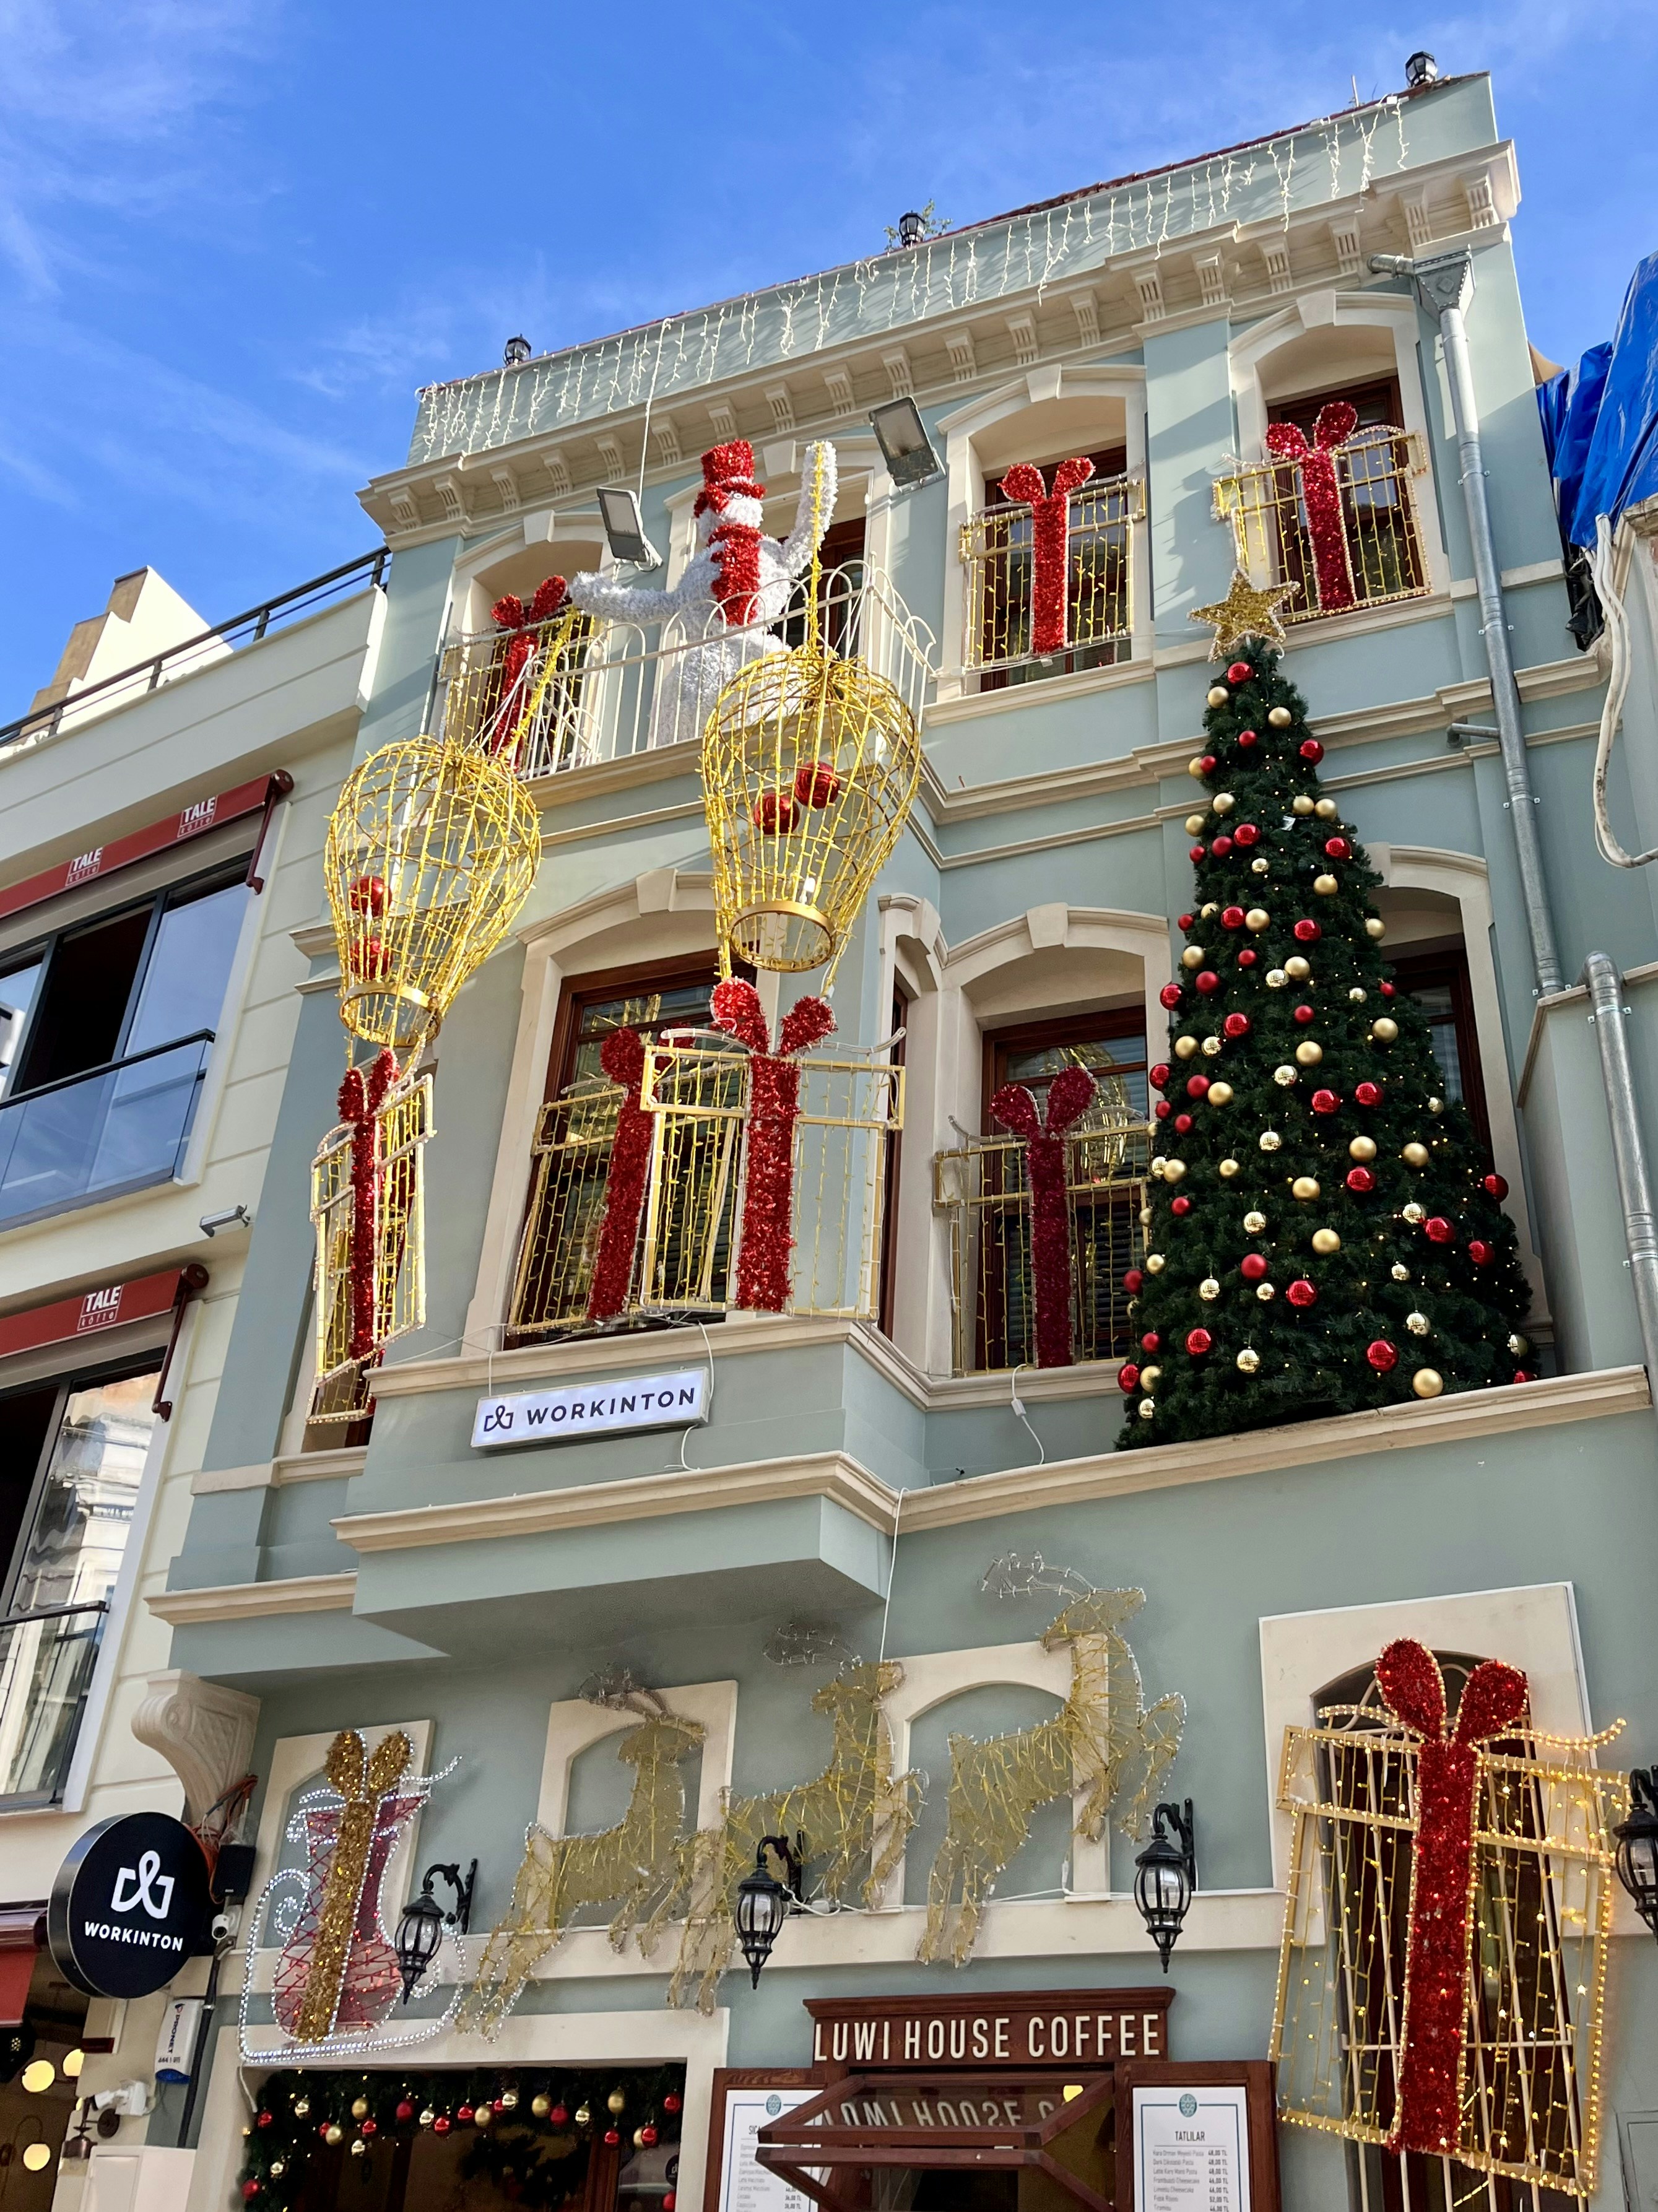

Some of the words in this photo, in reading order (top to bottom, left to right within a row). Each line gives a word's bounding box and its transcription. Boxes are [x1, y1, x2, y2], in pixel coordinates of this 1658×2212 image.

[183, 796, 215, 823] TALE
[72, 847, 103, 872] TALE
[86, 1285, 121, 1312] TALE
[527, 1387, 695, 1425] WORKINTON
[85, 1921, 183, 1951] WORKINTON
[814, 2021, 890, 2062] LUWI
[904, 2018, 1010, 2060] HOUSE
[1028, 2014, 1160, 2057] COFFEE
[1175, 2131, 1205, 2141] TATLILAR
